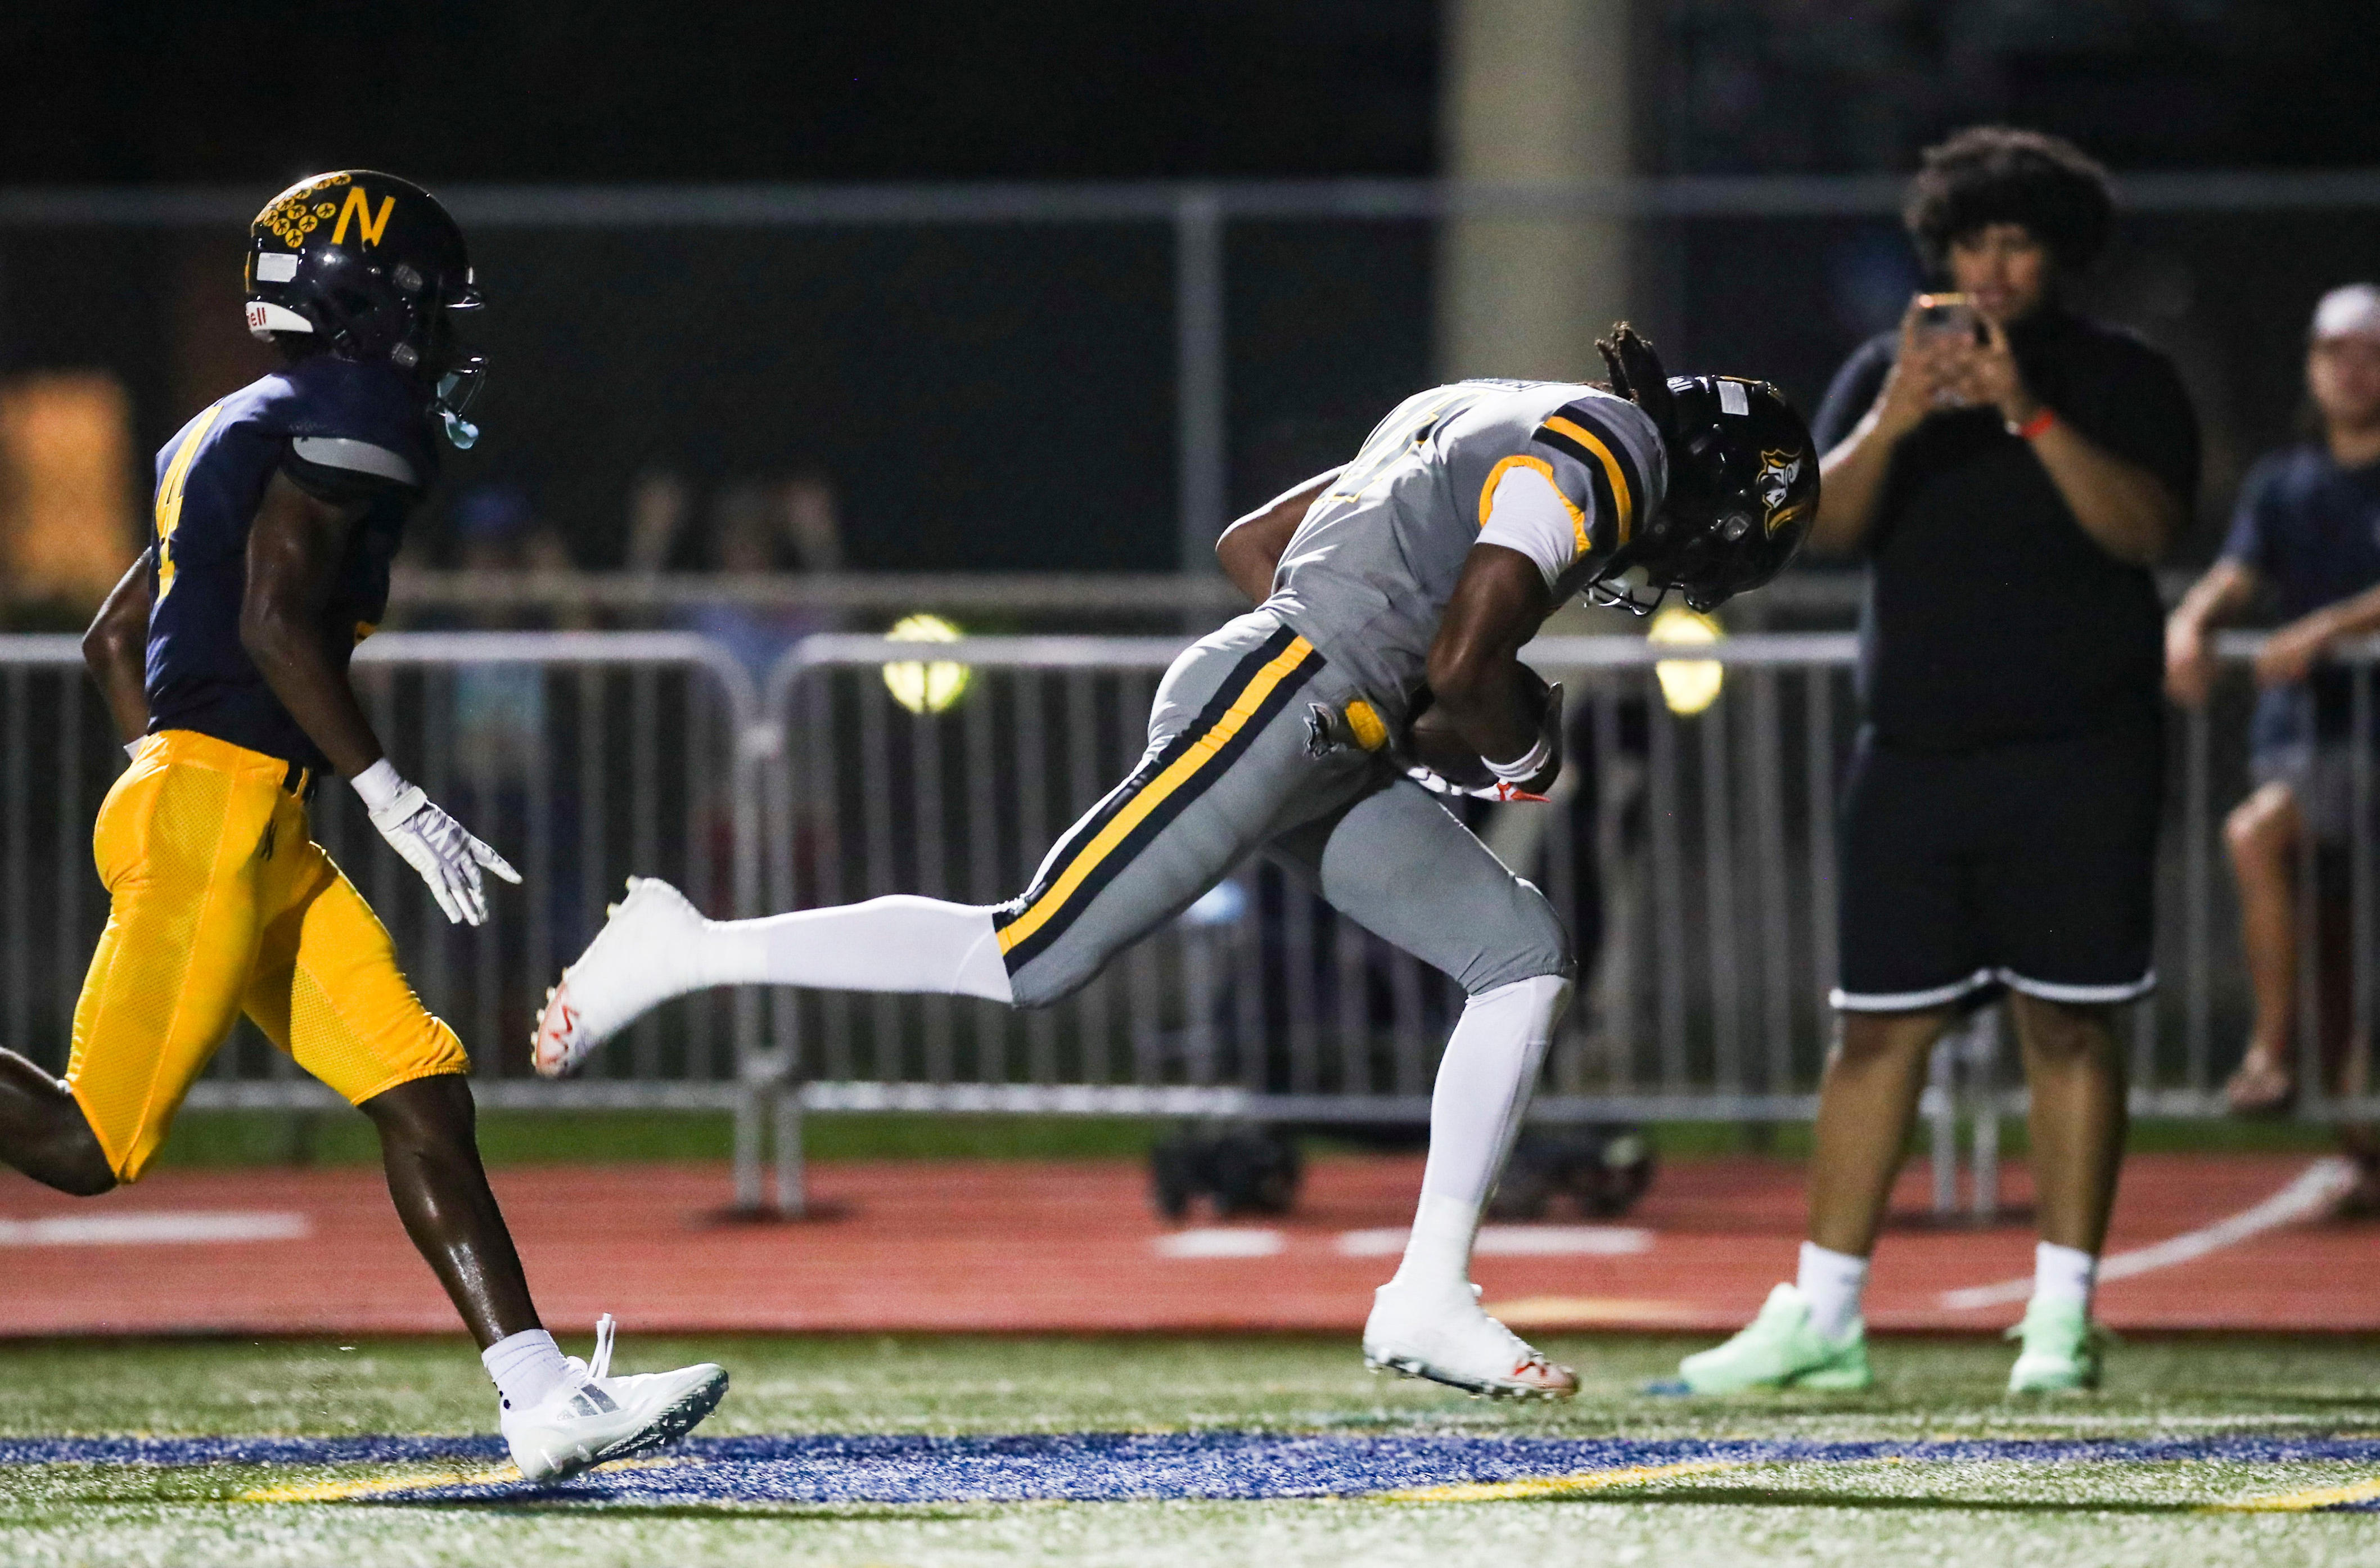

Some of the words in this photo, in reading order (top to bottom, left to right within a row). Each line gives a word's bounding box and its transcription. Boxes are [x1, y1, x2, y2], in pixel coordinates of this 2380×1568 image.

[332, 187, 396, 247] N
[248, 307, 266, 326] ell
[1666, 376, 1693, 393] ell
[156, 405, 224, 603] 4
